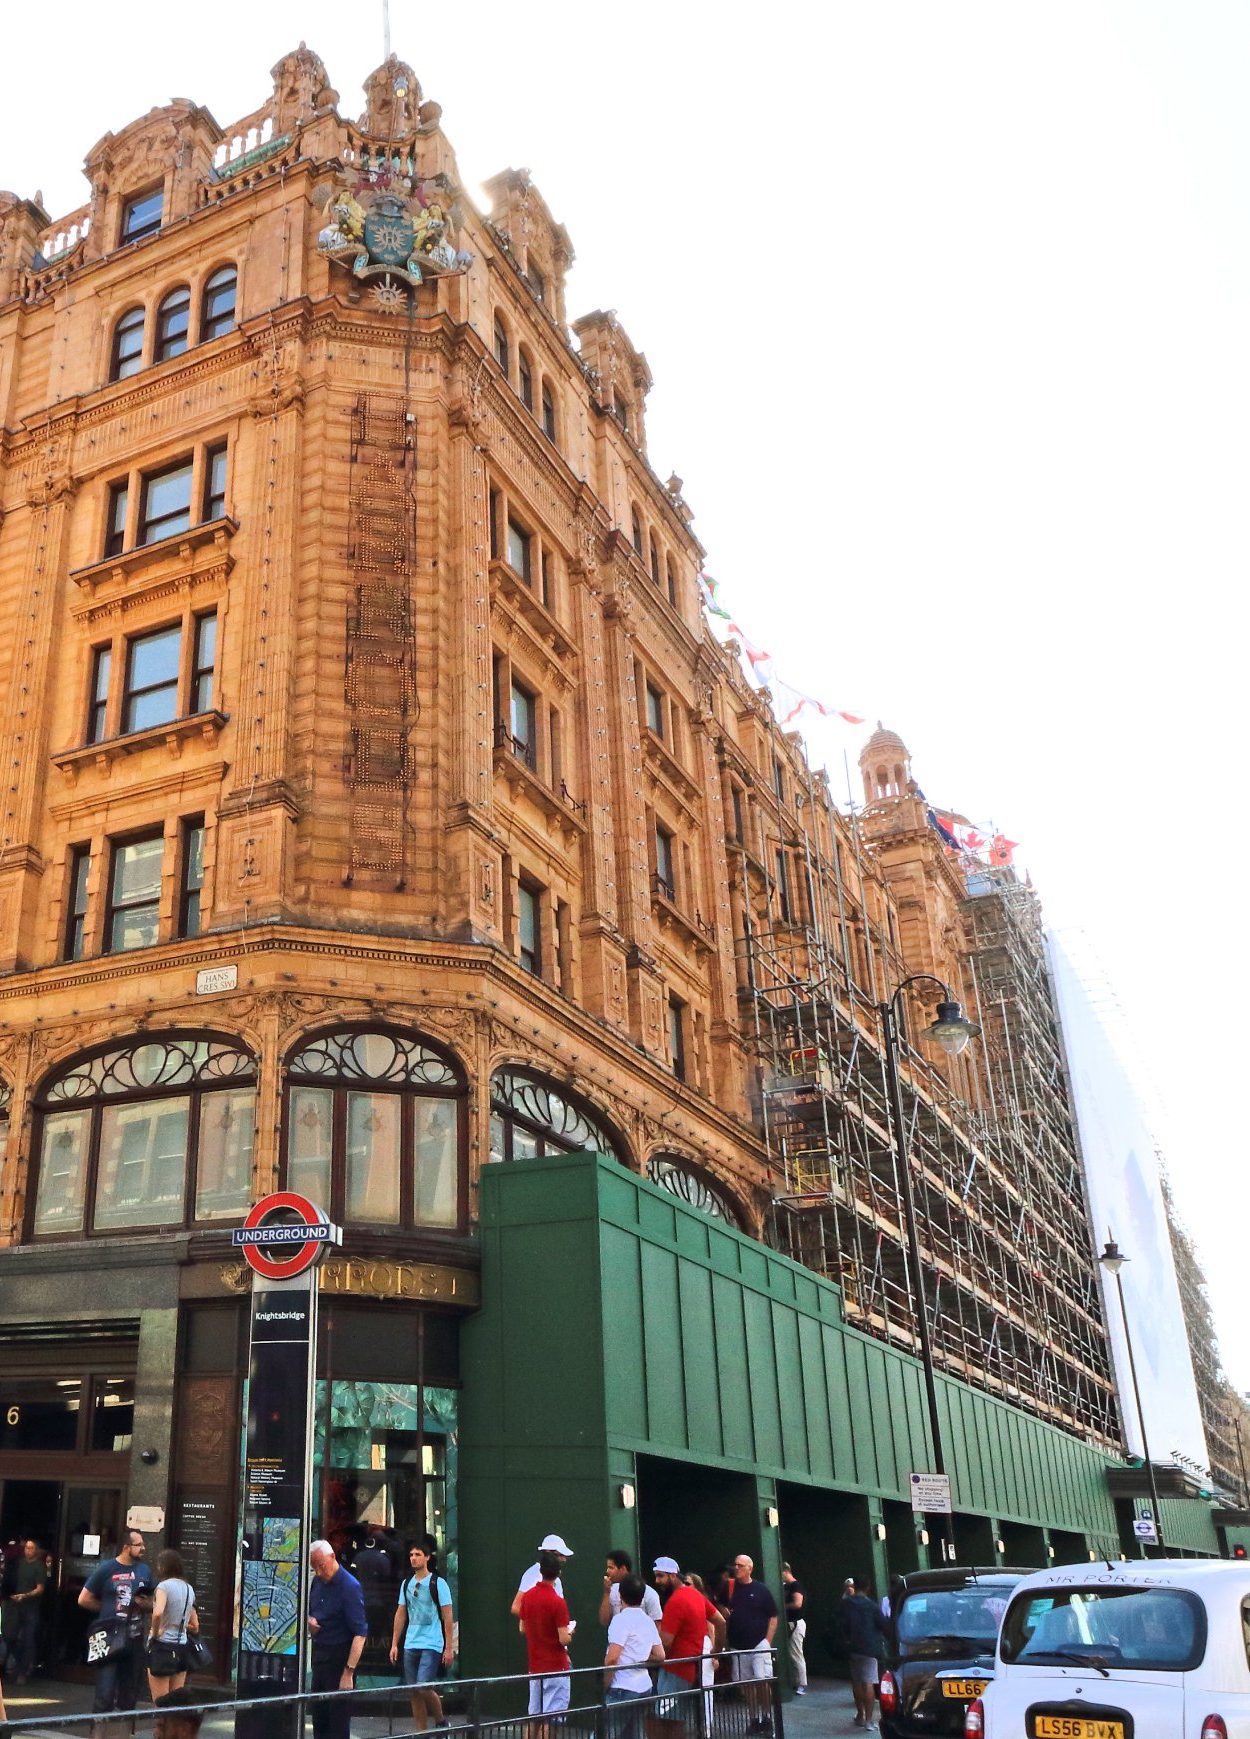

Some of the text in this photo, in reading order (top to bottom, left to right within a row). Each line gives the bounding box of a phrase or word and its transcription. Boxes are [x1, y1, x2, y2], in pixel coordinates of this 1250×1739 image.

[205, 971, 229, 984] HANS
[236, 1226, 328, 1242] UNDERGROUND
[318, 1262, 438, 1297] RRODS
[255, 1311, 306, 1322] Knightsbridge
[7, 1406, 19, 1425] 6
[1046, 1574, 1171, 1585] MR PORTER
[948, 1682, 982, 1696] LL66
[1041, 1718, 1118, 1739] LS56 BVX
